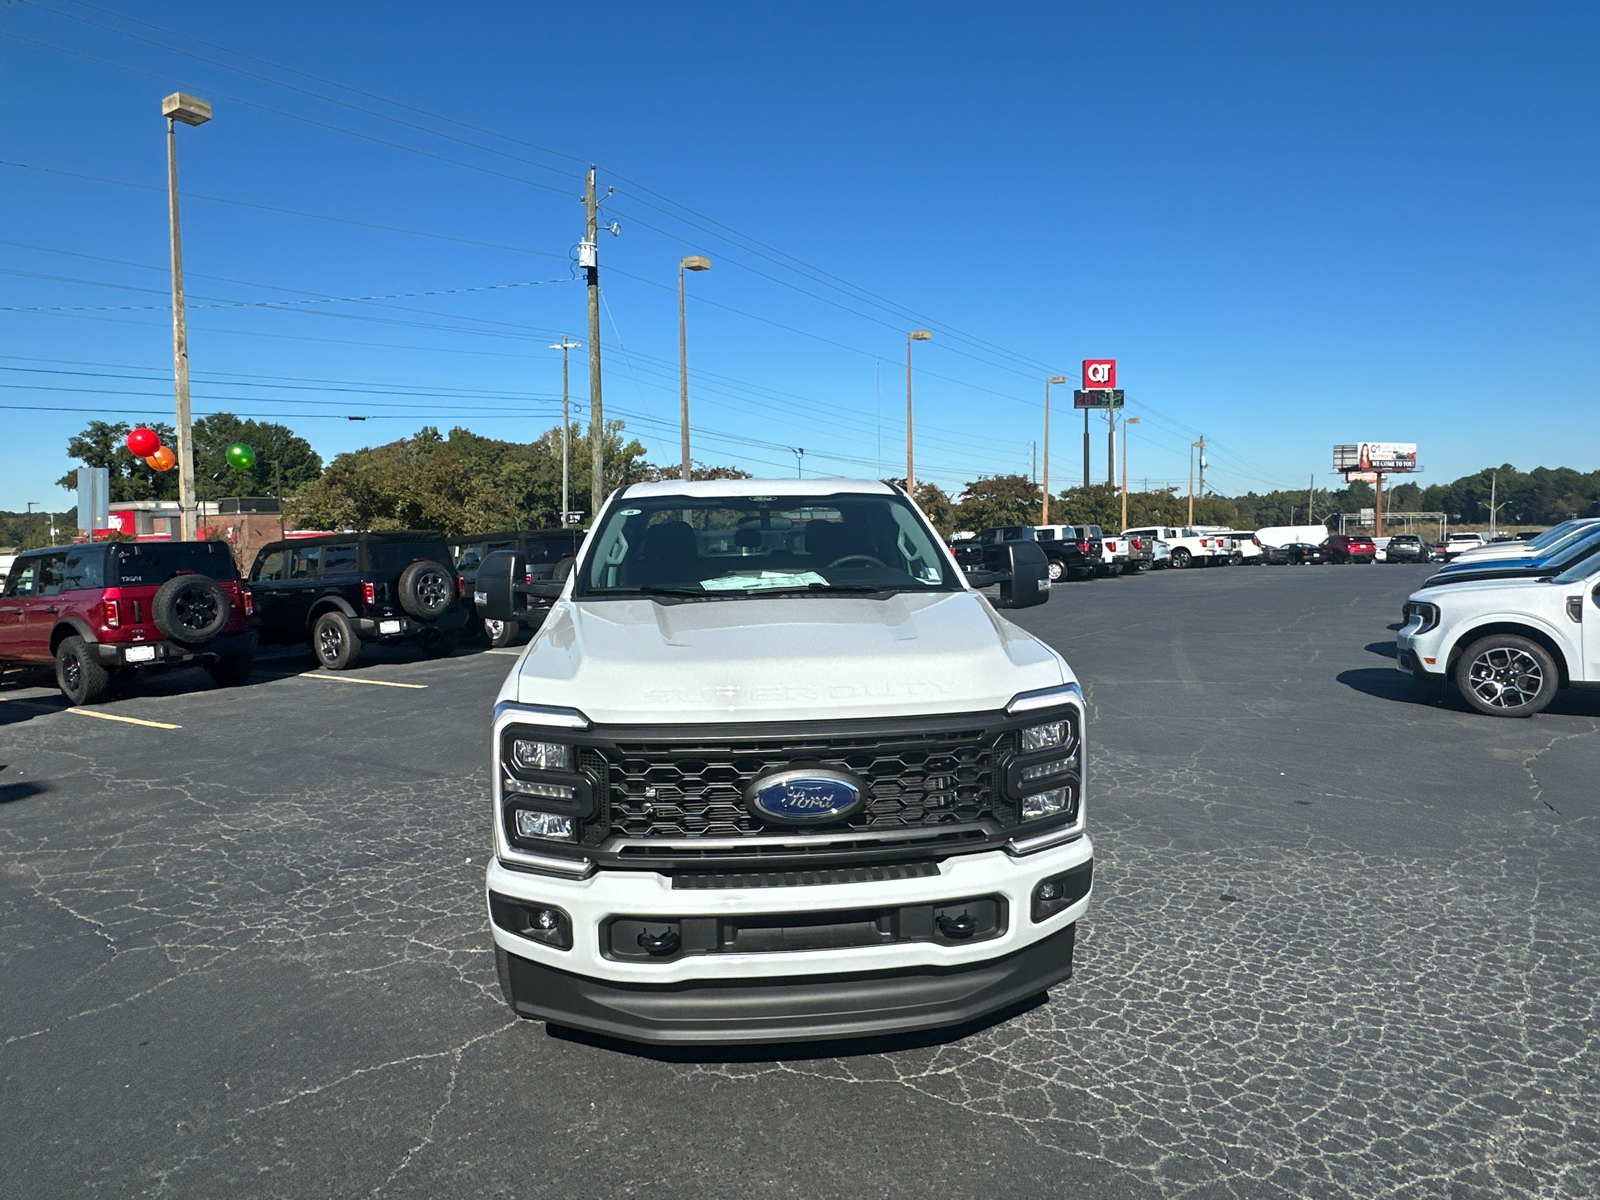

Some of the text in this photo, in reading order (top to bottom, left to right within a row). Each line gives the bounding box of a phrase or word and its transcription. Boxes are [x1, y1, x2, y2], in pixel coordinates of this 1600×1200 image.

[1087, 363, 1111, 383] QT
[829, 679, 957, 699] DUTY
[780, 785, 836, 811] Ford
